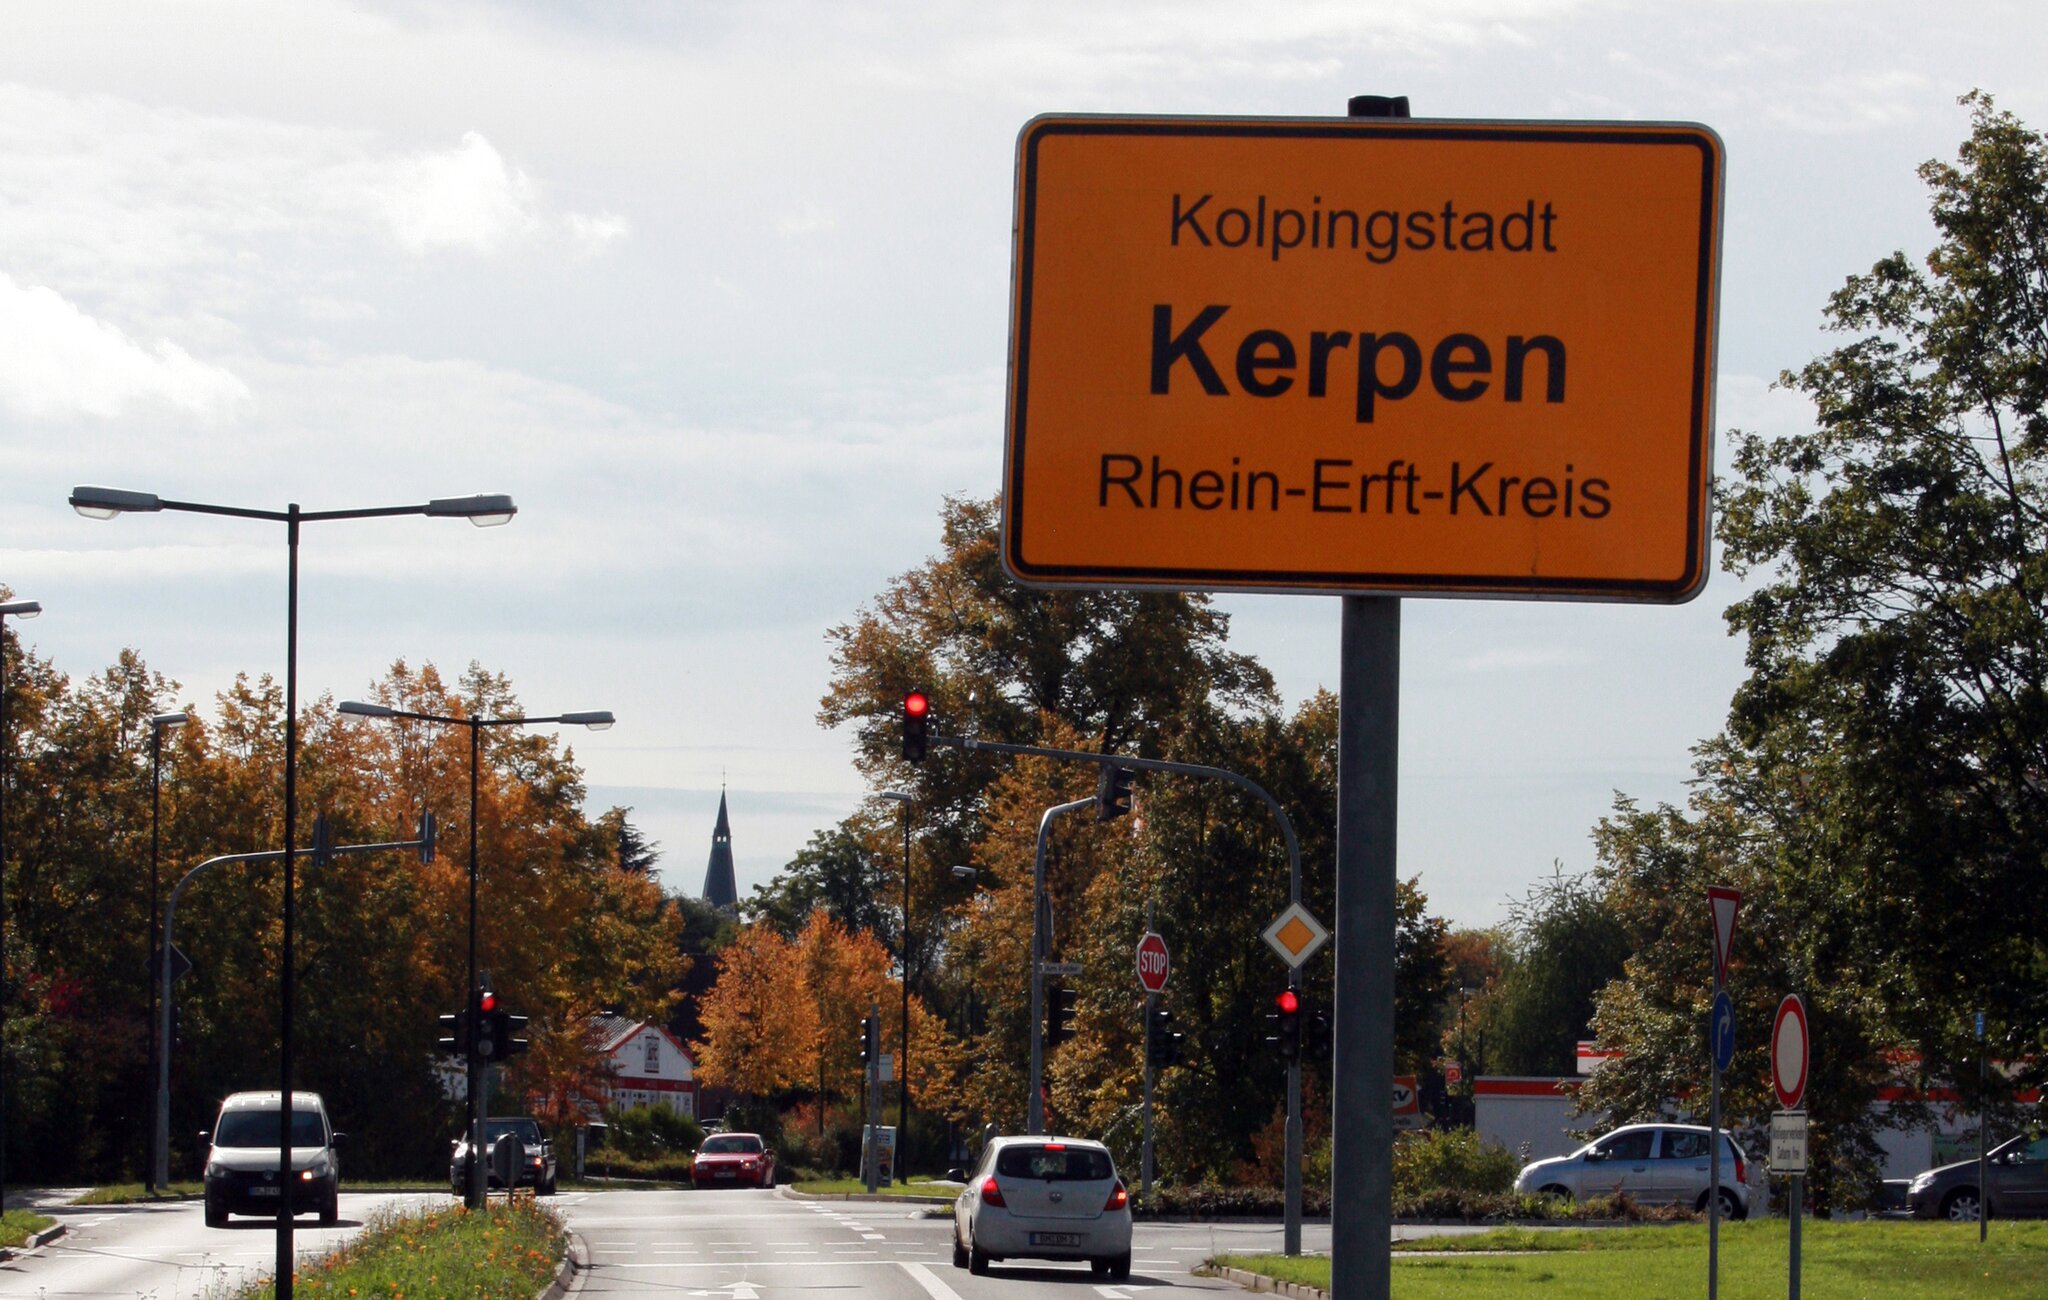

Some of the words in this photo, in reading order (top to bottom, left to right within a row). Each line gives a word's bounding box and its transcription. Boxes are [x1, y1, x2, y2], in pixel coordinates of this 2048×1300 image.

[1170, 193, 1557, 264] Kolpingstadt
[1150, 303, 1567, 424] Kerpen
[1099, 453, 1612, 519] Rhein-Erft-Kreis
[1141, 950, 1167, 975] STOP
